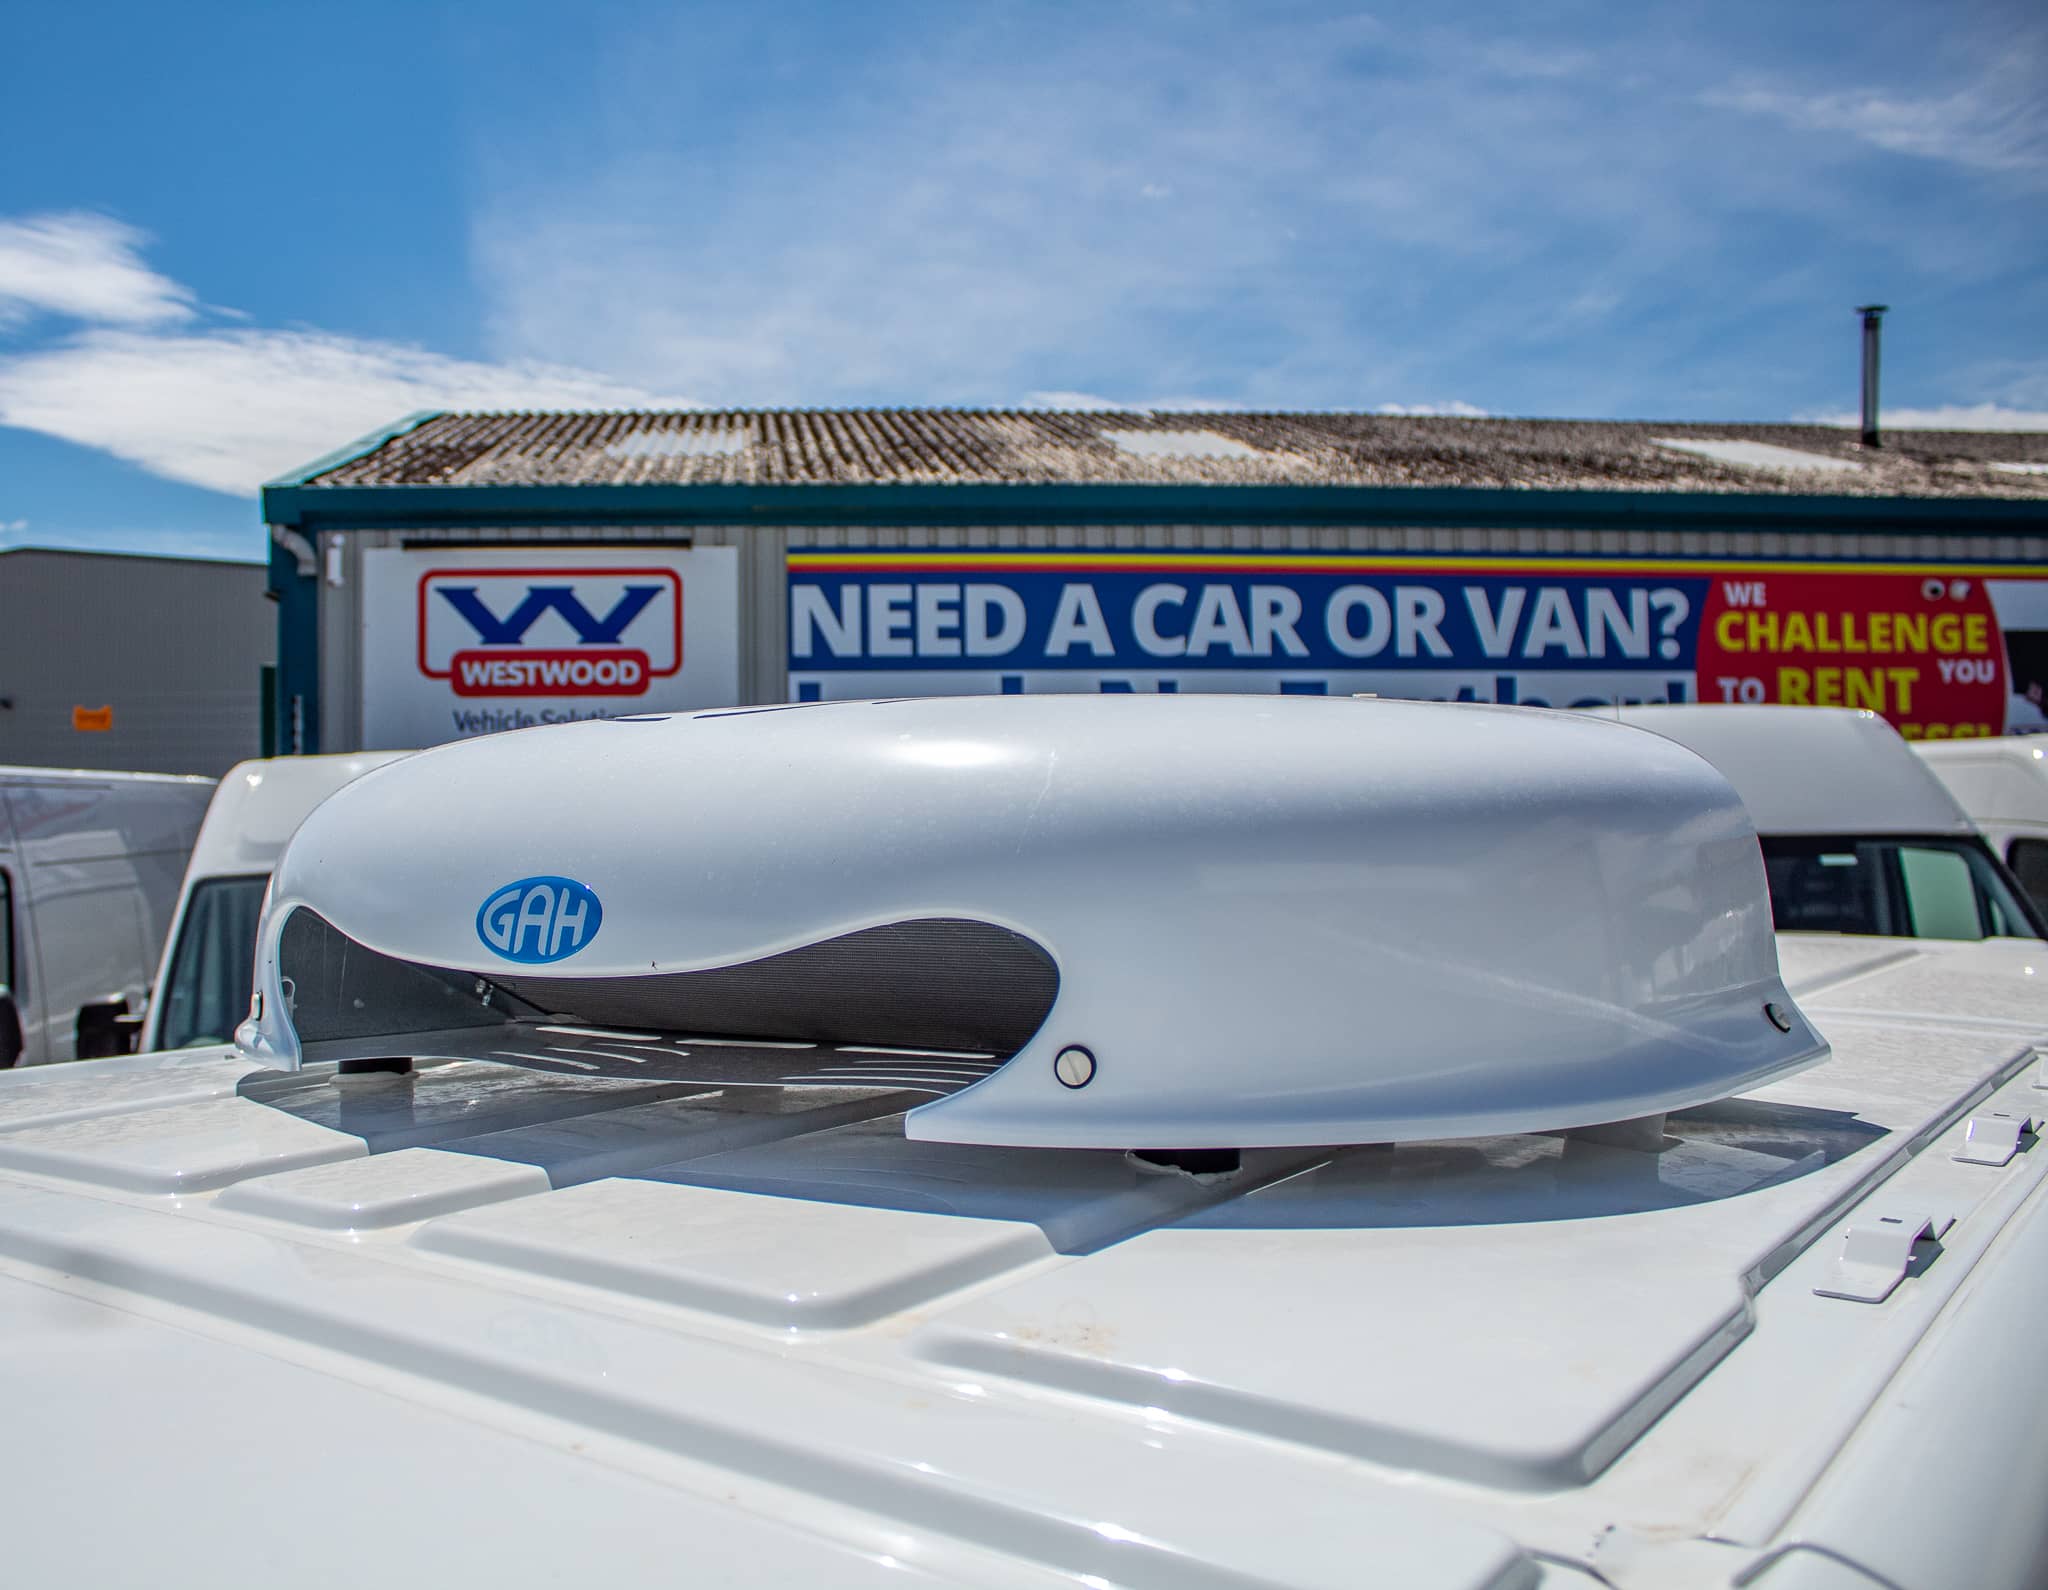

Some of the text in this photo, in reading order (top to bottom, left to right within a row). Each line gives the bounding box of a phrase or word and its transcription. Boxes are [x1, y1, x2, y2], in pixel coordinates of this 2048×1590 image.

[1722, 582, 1767, 607] WE
[791, 583, 1691, 660] NEED A CAR OR VAN?
[1715, 611, 1989, 653] CHALLENGE
[460, 660, 641, 687] WESTWOOD
[1936, 660, 1995, 683] YOU
[1717, 677, 1765, 703] TO
[1777, 667, 1920, 714] RENT
[452, 709, 534, 732] Vehicle
[482, 884, 588, 956] GAH
